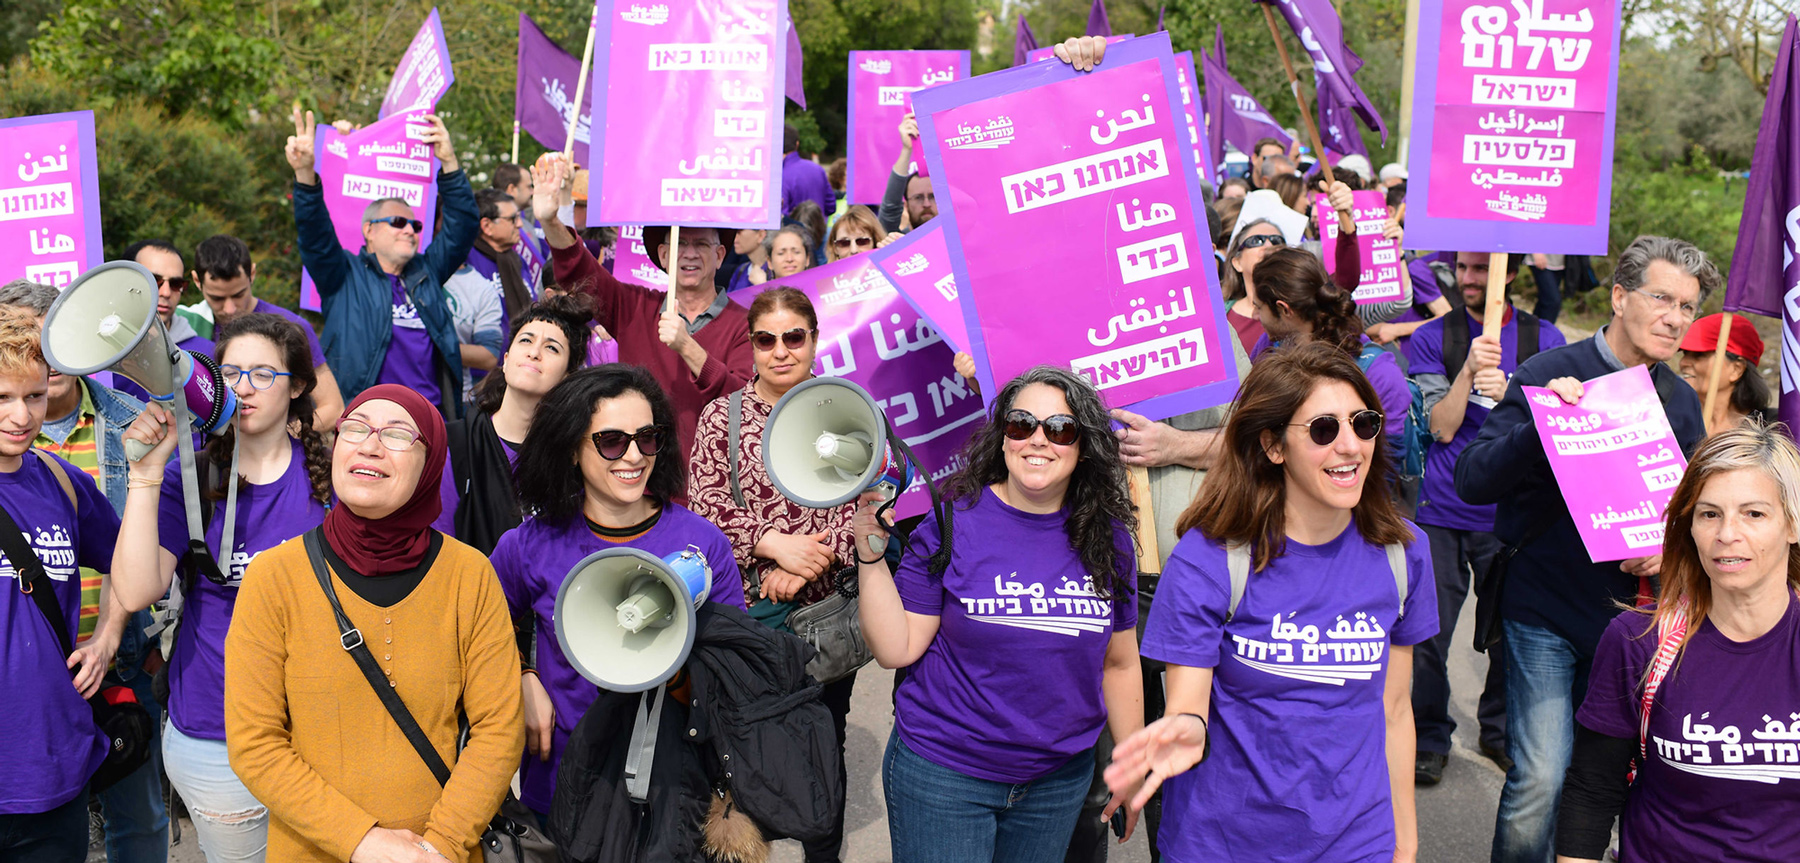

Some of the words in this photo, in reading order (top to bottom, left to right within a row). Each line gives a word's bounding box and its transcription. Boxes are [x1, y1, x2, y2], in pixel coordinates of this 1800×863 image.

[655, 50, 692, 68] כאן
[1460, 28, 1593, 72] שלום
[921, 65, 954, 86] نحن
[722, 79, 764, 102] هنا
[1481, 77, 1567, 102] ישראל
[721, 117, 758, 132] כדי
[985, 115, 1013, 133] نقف
[1090, 93, 1157, 146] نحن
[1478, 109, 1565, 138] إسرائيل
[945, 134, 974, 148] ביחד
[974, 127, 1015, 142] עומדים
[678, 147, 763, 178] لنبقى
[1474, 139, 1566, 161] פלסטין
[18, 144, 69, 182] نحن
[1073, 149, 1160, 189] אנחנו
[347, 180, 372, 194] כאן
[1010, 172, 1067, 209] כאן
[1470, 168, 1563, 190] فلسطين
[2, 190, 67, 214] אנחנו
[377, 184, 418, 201] אנחנו
[666, 184, 756, 203] להישאר
[1115, 198, 1177, 233] هنا
[29, 227, 75, 256] هنا
[1126, 243, 1179, 271] כדי
[1087, 285, 1197, 347] لنبقى
[1079, 337, 1198, 387] להישאר
[927, 371, 968, 419] אן
[1547, 413, 1603, 433] ويهود
[1637, 443, 1675, 467] ضد
[1651, 471, 1678, 485] נגד
[1589, 500, 1658, 530] انسفير
[35, 524, 72, 547] نقف
[994, 571, 1045, 599] معًا
[960, 597, 1023, 615] ביחד
[1030, 597, 1112, 617] עומדים
[1271, 611, 1320, 644] معًا
[1326, 611, 1386, 639] نقف
[1232, 634, 1295, 663] ביחד
[1301, 641, 1385, 663] עומדים
[1682, 711, 1742, 744] معًا
[1652, 735, 1713, 764] ביחד
